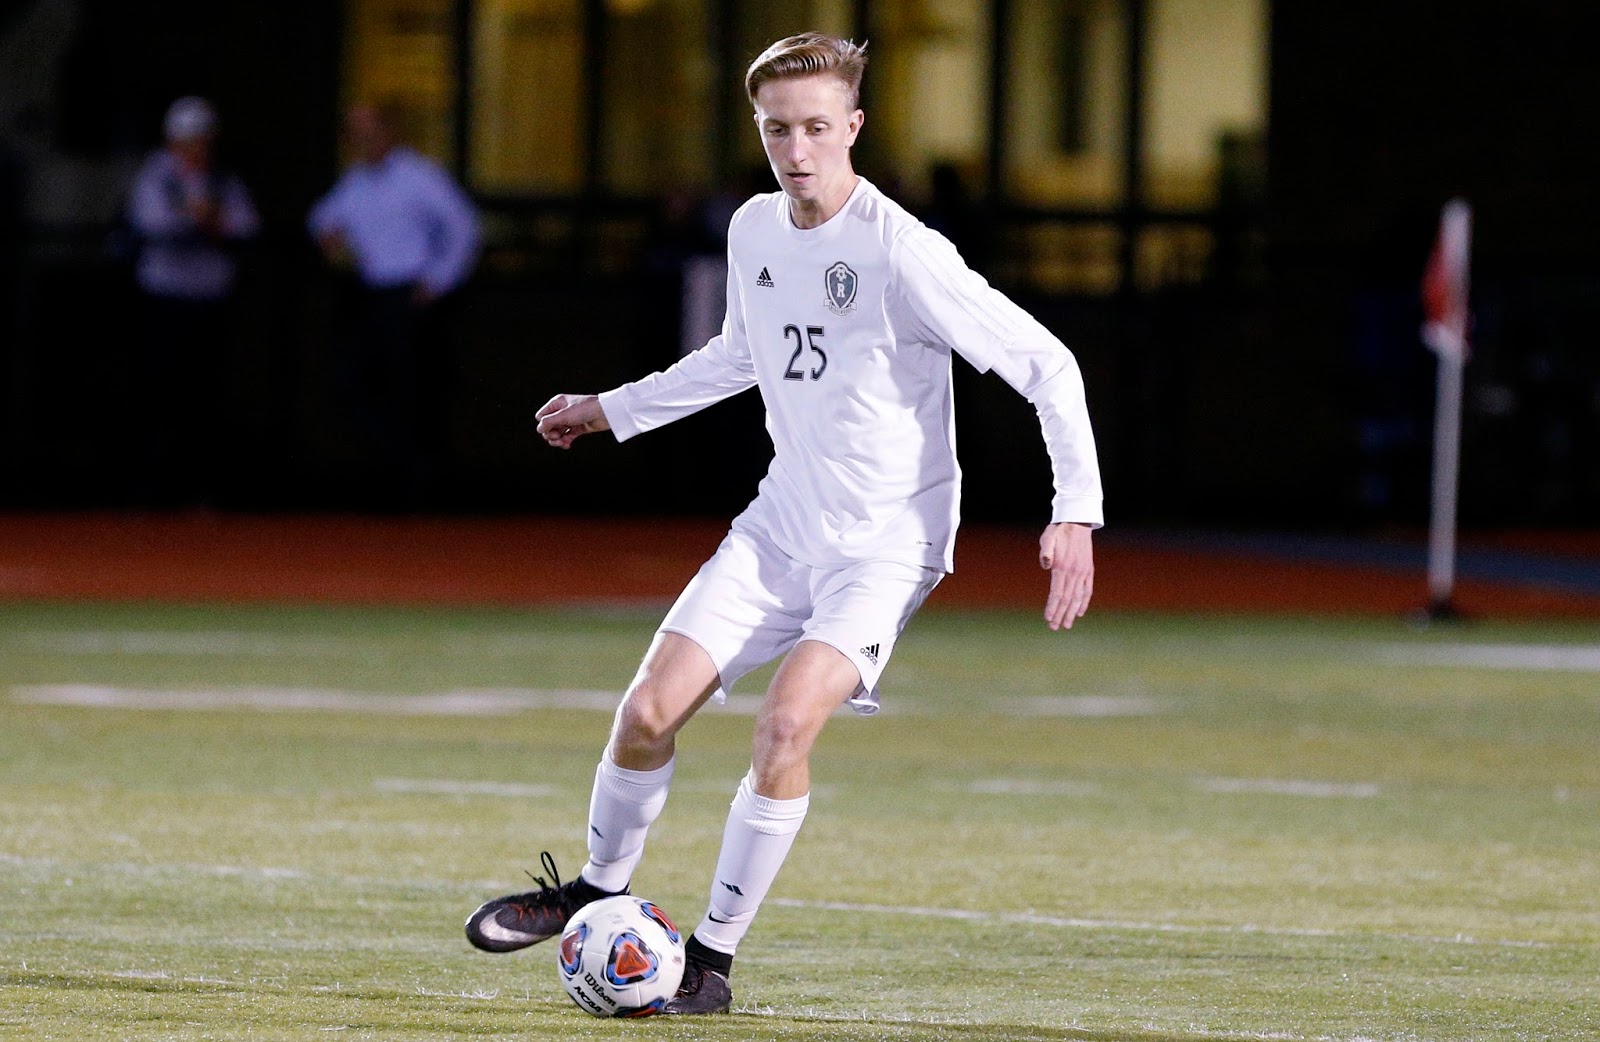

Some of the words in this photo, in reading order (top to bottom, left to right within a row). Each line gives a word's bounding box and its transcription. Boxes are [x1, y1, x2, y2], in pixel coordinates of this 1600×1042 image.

[756, 279, 775, 288] adidas
[836, 282, 846, 298] R
[783, 324, 828, 381] 25
[584, 971, 617, 1007] Wilson
